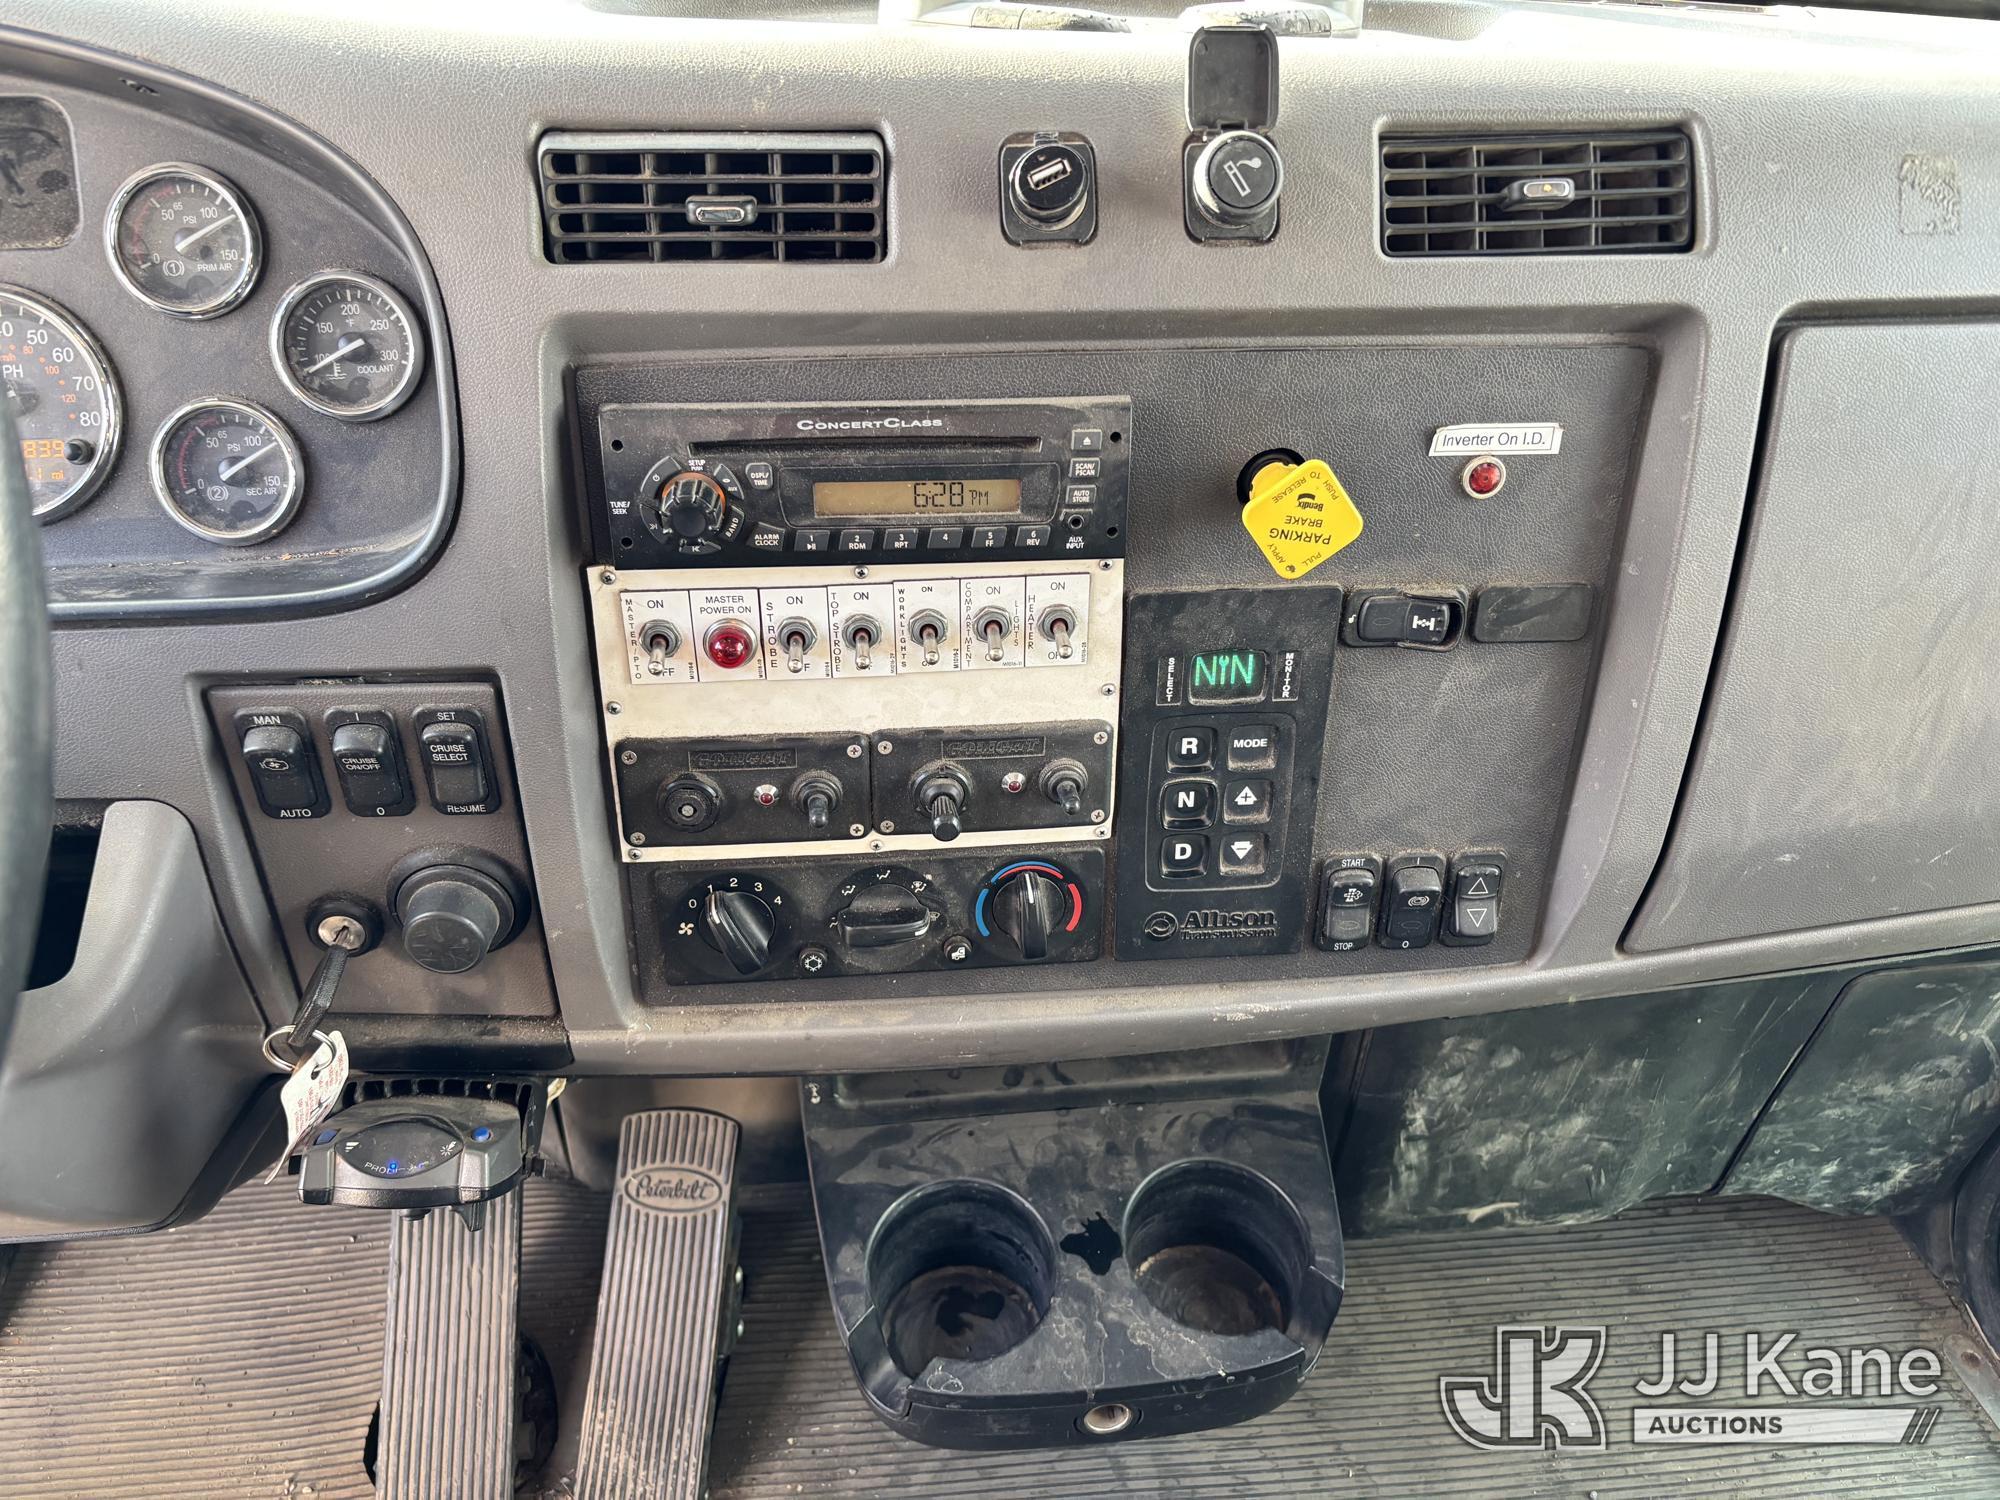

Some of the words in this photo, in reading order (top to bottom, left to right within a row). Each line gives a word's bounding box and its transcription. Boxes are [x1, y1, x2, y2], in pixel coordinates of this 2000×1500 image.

[173, 201, 183, 211] 65
[161, 209, 175, 221] 50
[200, 207, 218, 219] 100
[183, 215, 197, 225] PSI
[153, 253, 161, 264] 0
[220, 249, 238, 261] 150
[197, 263, 218, 272] PRIM
[219, 263, 233, 272] AIR
[340, 303, 360, 316] 200
[0, 321, 13, 337] 0
[316, 321, 334, 334] 150
[369, 319, 389, 331] 250
[27, 329, 48, 345] 50
[52, 347, 74, 363] 60
[379, 350, 399, 361] 300
[1, 364, 24, 379] PH
[357, 364, 394, 374] COOLANT
[72, 375, 94, 391] 70
[79, 411, 101, 427] 80
[217, 430, 228, 439] 65
[1442, 433, 1494, 447] Inverter
[1497, 432, 1518, 446] On
[1522, 432, 1546, 445] I.D.
[206, 437, 219, 449] 50
[243, 436, 262, 447] 100
[227, 443, 241, 452] PSI
[263, 475, 281, 487] 150
[1309, 471, 1321, 480] TO
[197, 479, 204, 490] 0
[1271, 476, 1308, 504] RELEASE
[1322, 479, 1340, 501] PUSH
[246, 488, 262, 496] SEC
[263, 487, 278, 495] AIR
[913, 481, 964, 508] 6:28
[968, 489, 989, 506] PM
[1072, 495, 1090, 503] STORE
[609, 501, 631, 509] TUNE/
[1297, 501, 1324, 512] Bendix
[612, 507, 628, 515] SEEK
[1284, 515, 1323, 528] BRAKE
[725, 517, 739, 538] BAND
[899, 533, 905, 541] 3
[942, 533, 949, 541] 4
[987, 531, 993, 539] 5
[1030, 530, 1036, 538] 6
[1269, 527, 1332, 545] PARKING
[755, 538, 779, 546] CLOCK
[894, 541, 909, 549] RPT
[985, 539, 994, 547] FF
[1026, 538, 1041, 546] REV
[1066, 541, 1085, 549] INPUT
[1267, 543, 1287, 564] APPLY
[1301, 552, 1322, 566] PULL
[985, 586, 1001, 595] ON
[1050, 581, 1066, 591] ON
[705, 595, 745, 604] MASTER
[786, 596, 804, 605] ON
[853, 591, 870, 600] ON
[647, 600, 664, 609] ON
[700, 606, 736, 614] POWER
[737, 605, 752, 613] ON
[830, 592, 839, 618] TOP
[964, 582, 973, 667] COMPARTMENT
[1027, 594, 1036, 650] HEATER
[898, 588, 907, 668] WORKLIGHTS
[766, 602, 778, 669] STROBE
[832, 622, 842, 672] STROBE
[1166, 657, 1175, 702] SELECT
[1282, 652, 1294, 698] MONITOR
[254, 715, 281, 725] MAN
[437, 711, 456, 721] SET
[429, 744, 466, 753] CRUISE
[1181, 737, 1198, 755] R
[1233, 738, 1268, 749] MODE
[341, 757, 378, 765] CRUISE
[432, 753, 468, 762] SELECT
[345, 763, 382, 771] ON/OFF
[1178, 791, 1195, 808] N
[280, 808, 312, 818] AUTO
[447, 804, 487, 813] RESUME
[1174, 843, 1192, 860] D
[1341, 858, 1365, 867] START
[730, 878, 738, 888] 2
[754, 882, 763, 892] 3
[774, 895, 782, 905] 4
[1180, 910, 1278, 928] Allison
[1180, 927, 1278, 940] Transmission
[1333, 942, 1353, 950] STOP
[635, 1174, 715, 1200] Peterbilt
